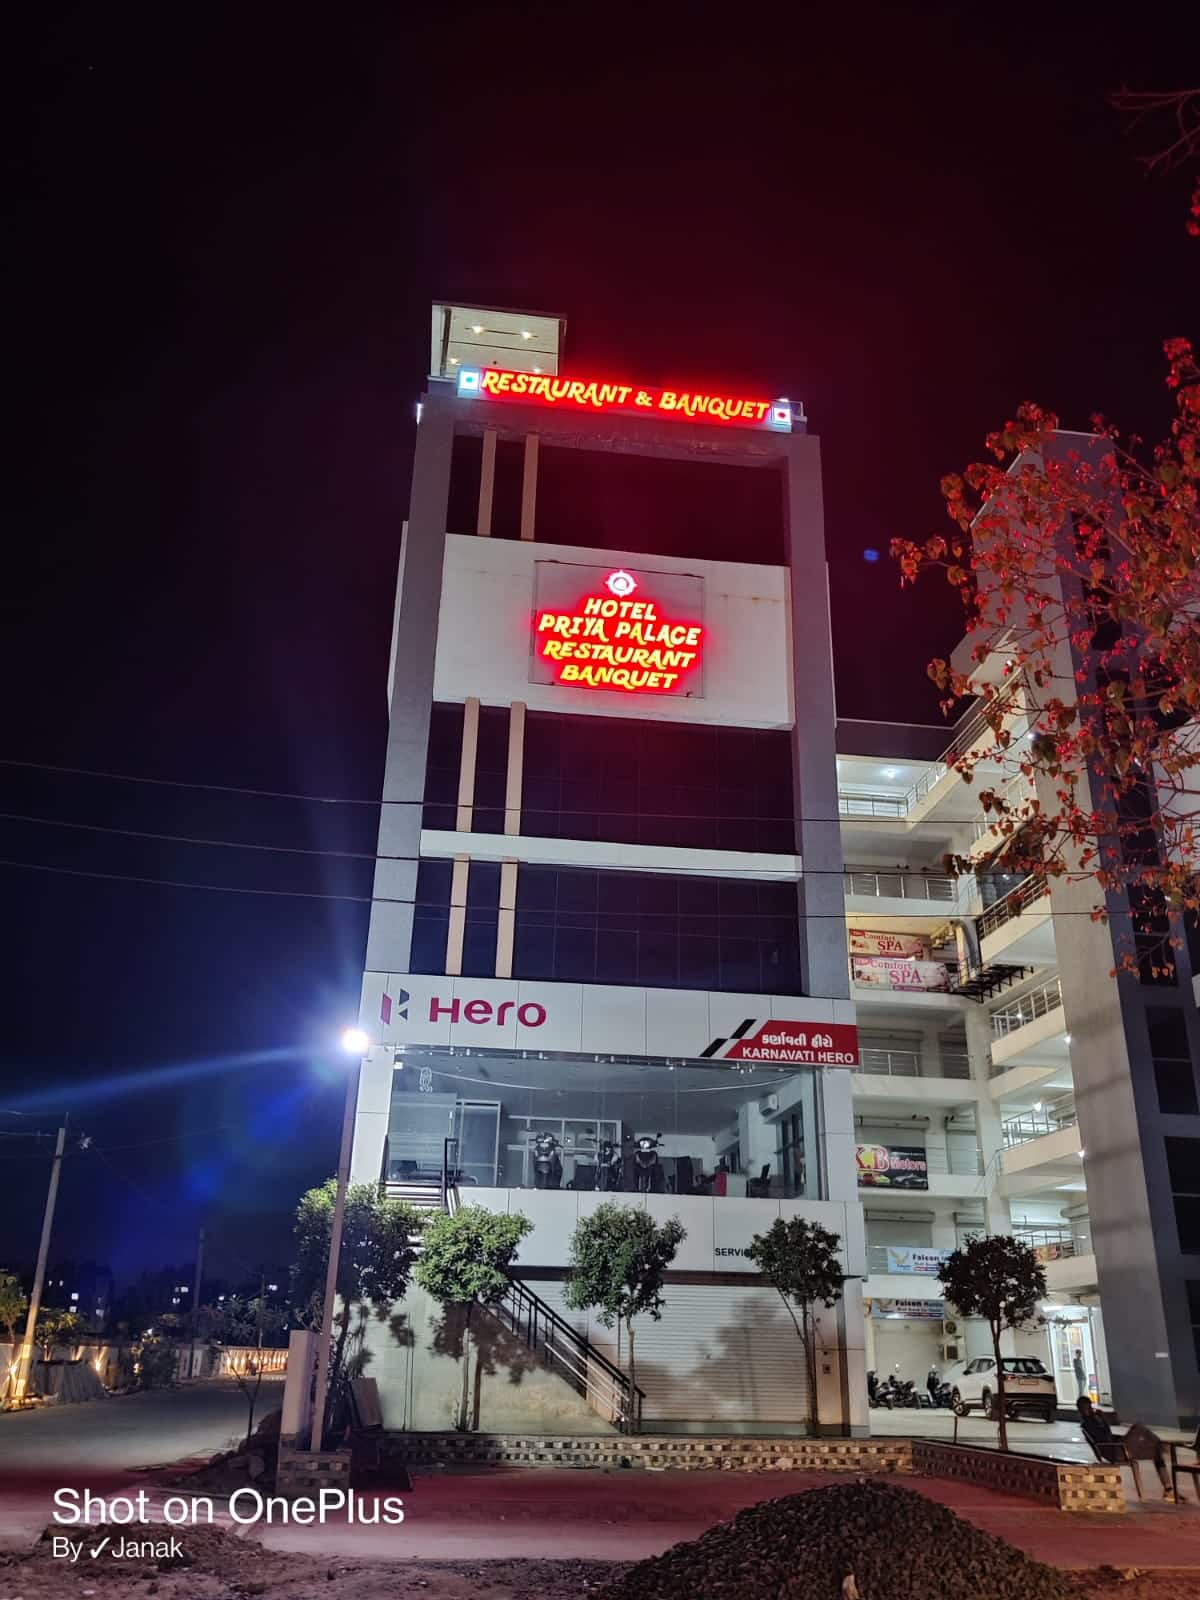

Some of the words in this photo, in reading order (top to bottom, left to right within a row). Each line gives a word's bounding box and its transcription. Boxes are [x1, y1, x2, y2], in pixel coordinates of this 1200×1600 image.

[482, 371, 632, 407] RESTAURANT
[635, 391, 652, 407] &
[658, 391, 770, 420] BANQUET
[584, 598, 657, 621] HOTEL
[538, 613, 609, 642] PRIYA
[615, 621, 702, 648] PALACE
[543, 640, 695, 670] RESTAURANT
[560, 664, 678, 690] BANQUET
[878, 940, 904, 951] SPA
[871, 959, 912, 969] Comfort
[889, 969, 922, 984] SPA
[429, 997, 547, 1028] Hero
[742, 1048, 814, 1062] KARNAVATI
[818, 1051, 855, 1064] HERO
